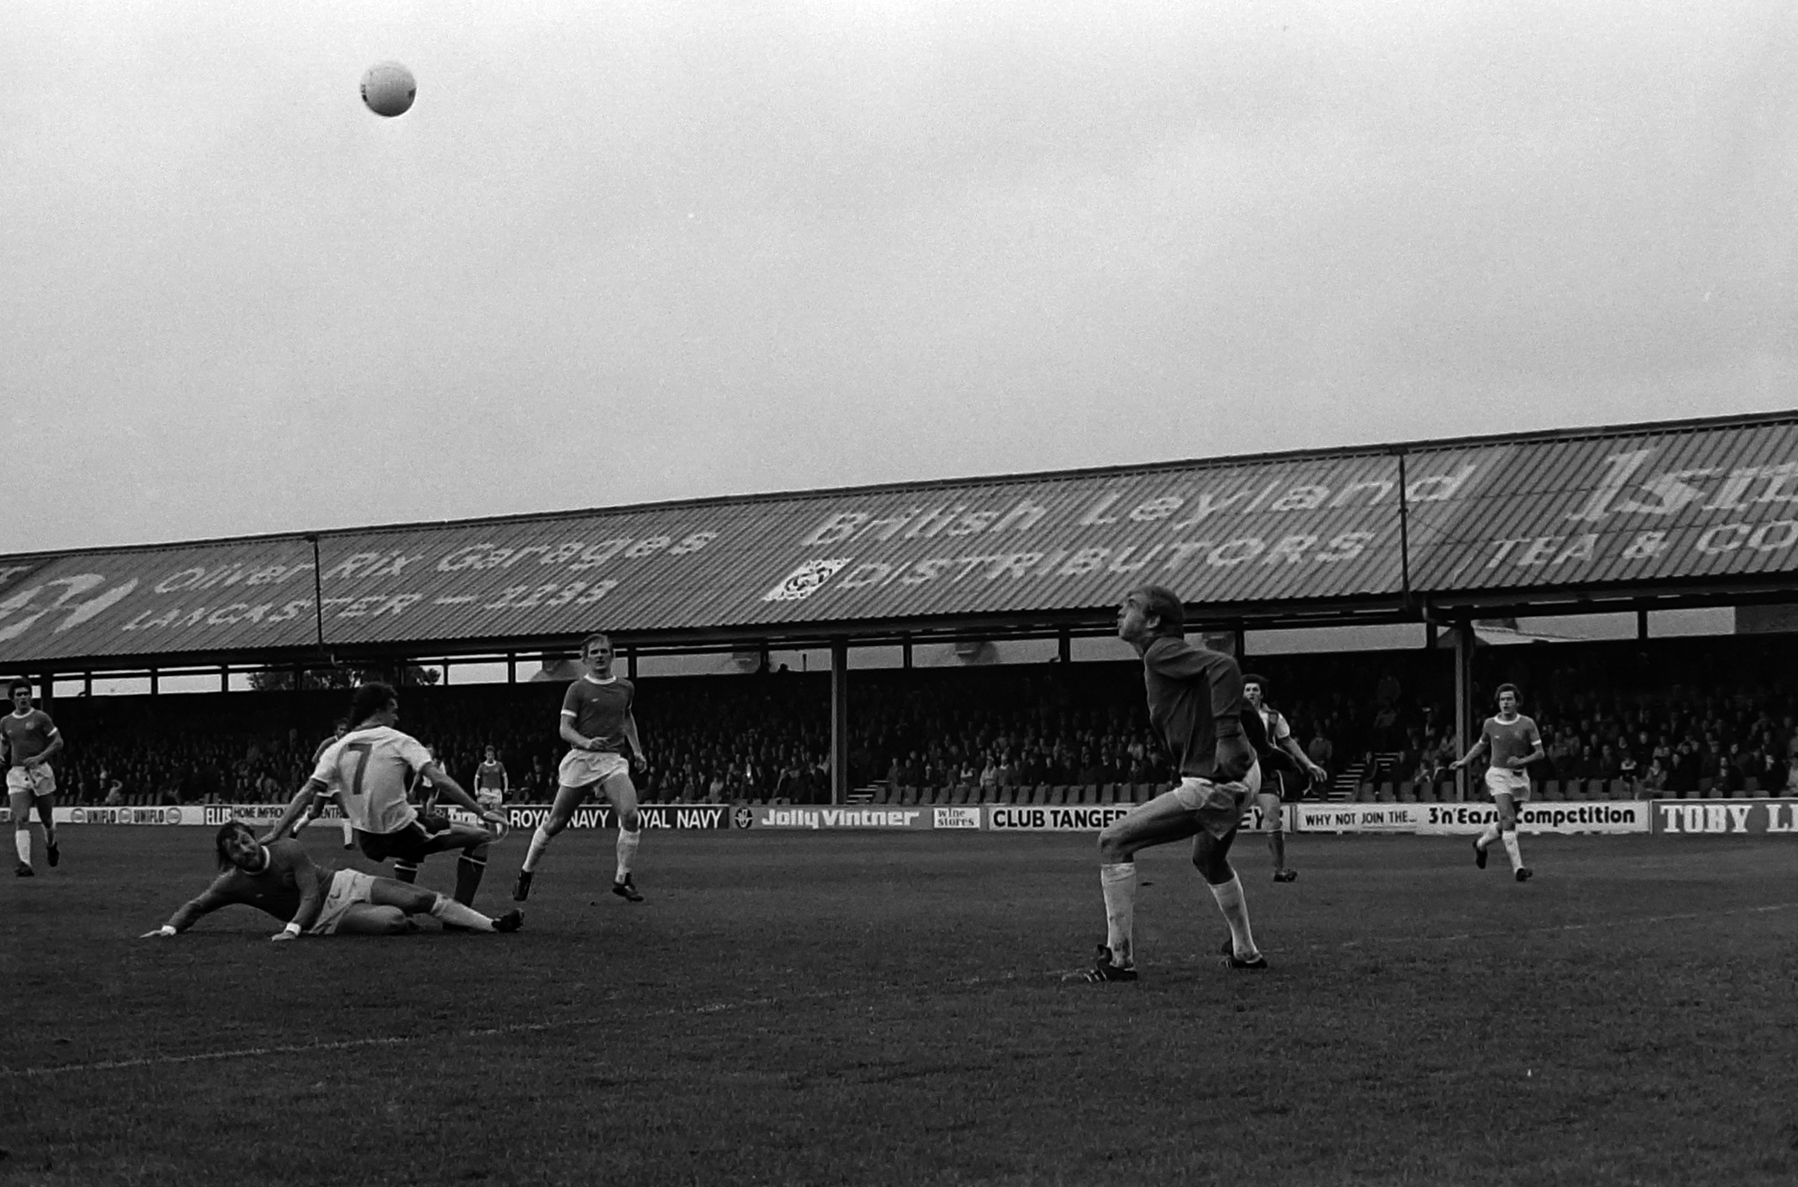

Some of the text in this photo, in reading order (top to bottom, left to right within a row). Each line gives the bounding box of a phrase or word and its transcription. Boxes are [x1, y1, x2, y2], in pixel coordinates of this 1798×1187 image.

[801, 464, 1476, 546] British Leyland
[154, 531, 718, 593] Oliver Rix Garages
[835, 532, 1375, 589] DISTRIBUTORS
[1486, 533, 1599, 568] TEA
[347, 743, 373, 795] 7
[511, 809, 609, 828] ROYA NAVY
[677, 809, 722, 829] NAVY
[762, 809, 920, 829] Jolly Vintner
[993, 809, 1045, 828] CLUB
[1305, 813, 1331, 826] WHY
[1336, 812, 1356, 825] NOT
[1361, 811, 1385, 825] JOIN
[1660, 804, 1753, 832] TOBY
